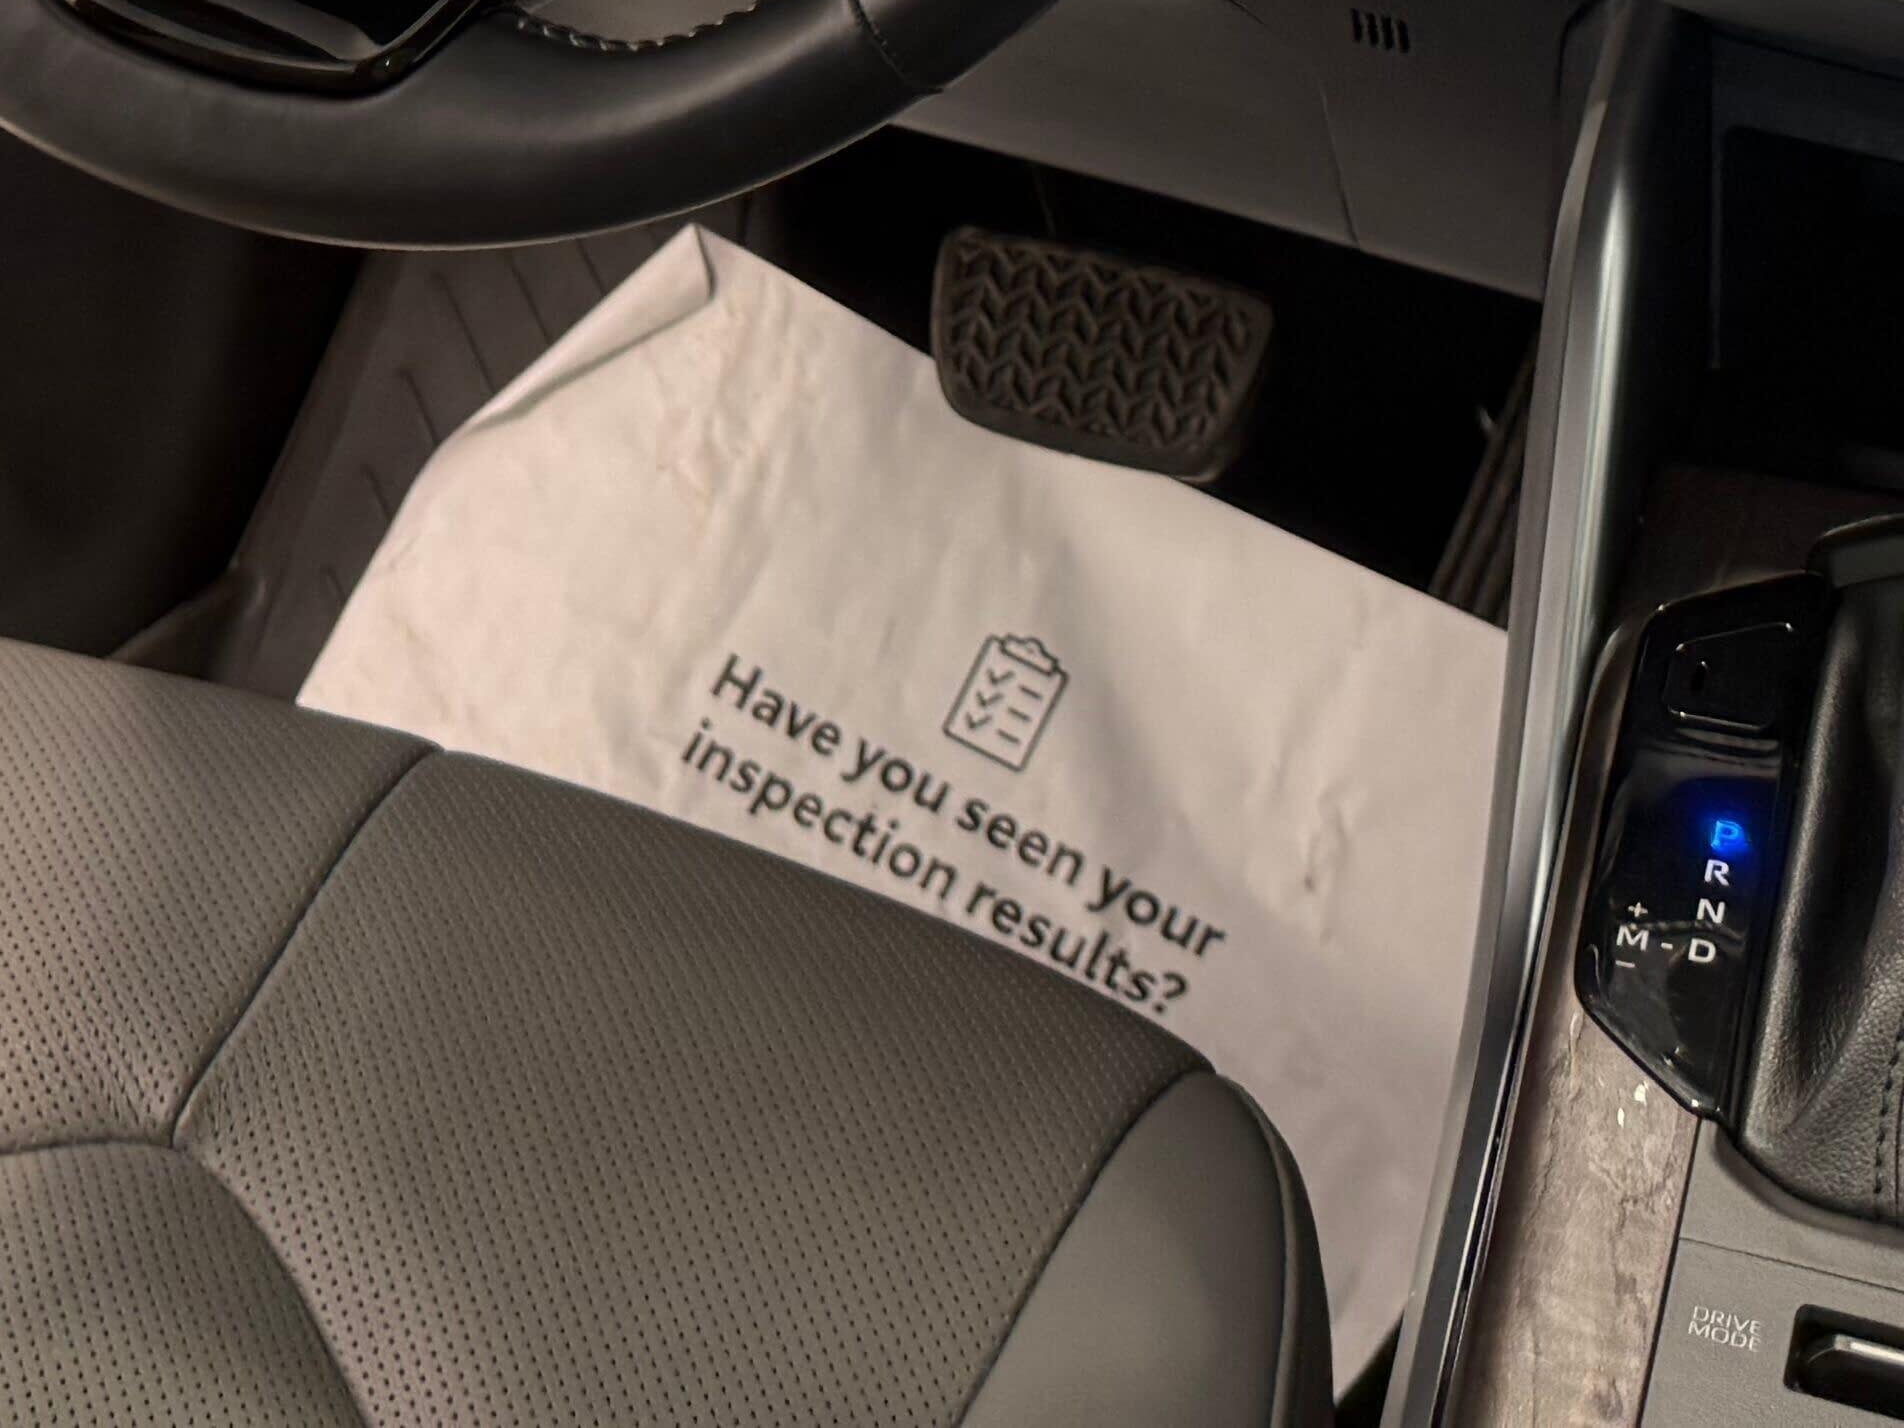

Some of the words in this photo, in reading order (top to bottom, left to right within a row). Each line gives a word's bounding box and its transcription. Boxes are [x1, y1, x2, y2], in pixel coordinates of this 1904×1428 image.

[711, 651, 843, 756] Have
[841, 738, 951, 816] you
[957, 793, 1087, 887] seen
[1087, 864, 1228, 958] your
[1710, 819, 1744, 848] P
[680, 718, 960, 901] inspection
[966, 880, 1191, 1014] results?
[1704, 859, 1730, 887] R
[1696, 898, 1725, 924] N
[1616, 924, 1650, 952] M
[1687, 937, 1717, 963] D
[1687, 1321, 1763, 1353] MODE
[1691, 1305, 1764, 1338] DRIVE
